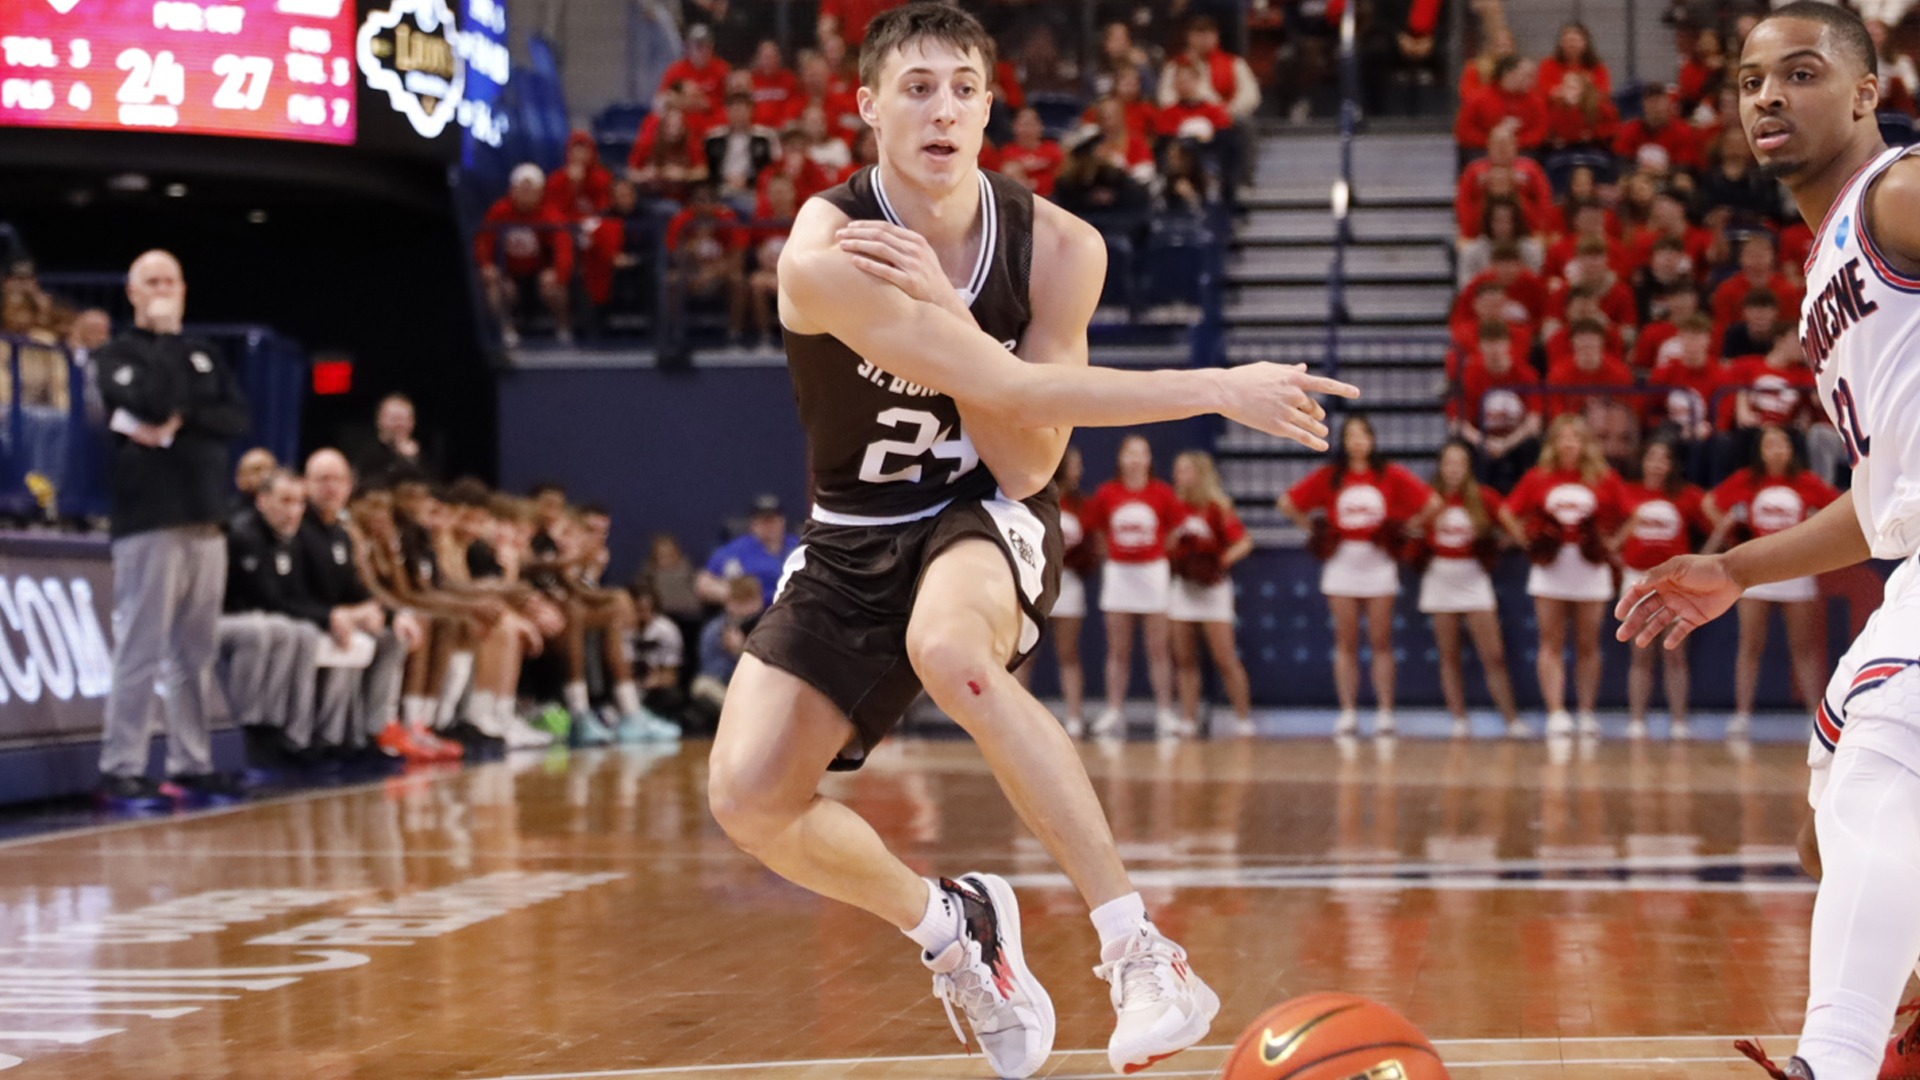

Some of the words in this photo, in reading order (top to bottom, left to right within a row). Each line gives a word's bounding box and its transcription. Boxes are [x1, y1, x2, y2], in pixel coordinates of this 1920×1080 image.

[116, 48, 185, 105] 24
[212, 54, 274, 110] 27
[858, 407, 980, 485] 24
